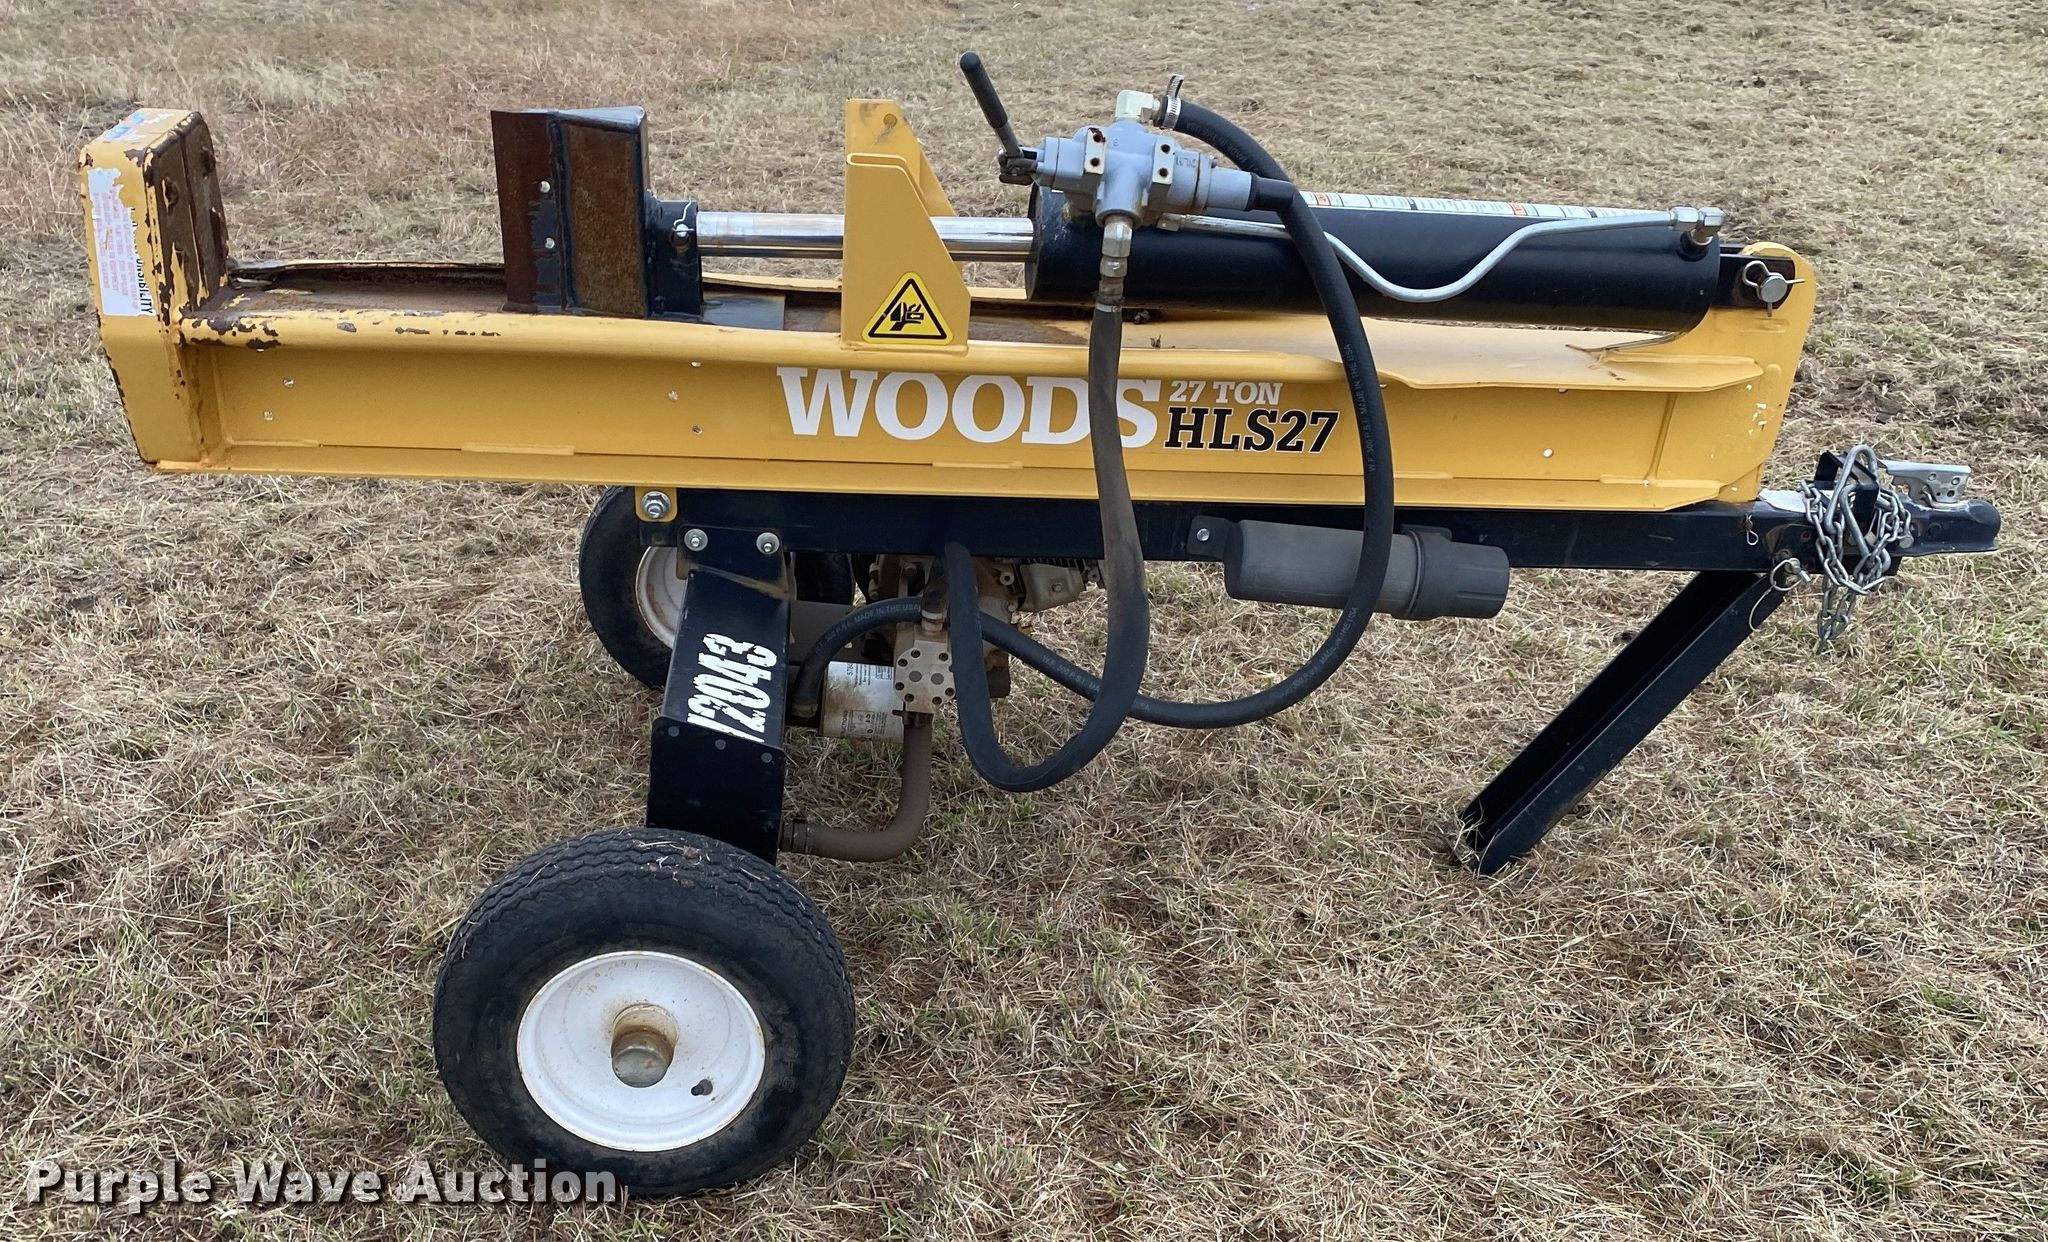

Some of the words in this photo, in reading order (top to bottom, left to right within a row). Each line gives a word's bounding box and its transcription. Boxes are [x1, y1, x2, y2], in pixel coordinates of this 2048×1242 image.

[1343, 343, 1354, 361] USA
[1349, 362, 1361, 379] THE
[1168, 380, 1207, 403] 27
[1212, 381, 1284, 405] TON
[1353, 381, 1362, 391] IN
[776, 367, 1160, 447] WOODS
[1356, 392, 1368, 415] MADE
[1163, 406, 1341, 454] HLS27
[886, 604, 901, 613] THE
[902, 602, 919, 612] USA
